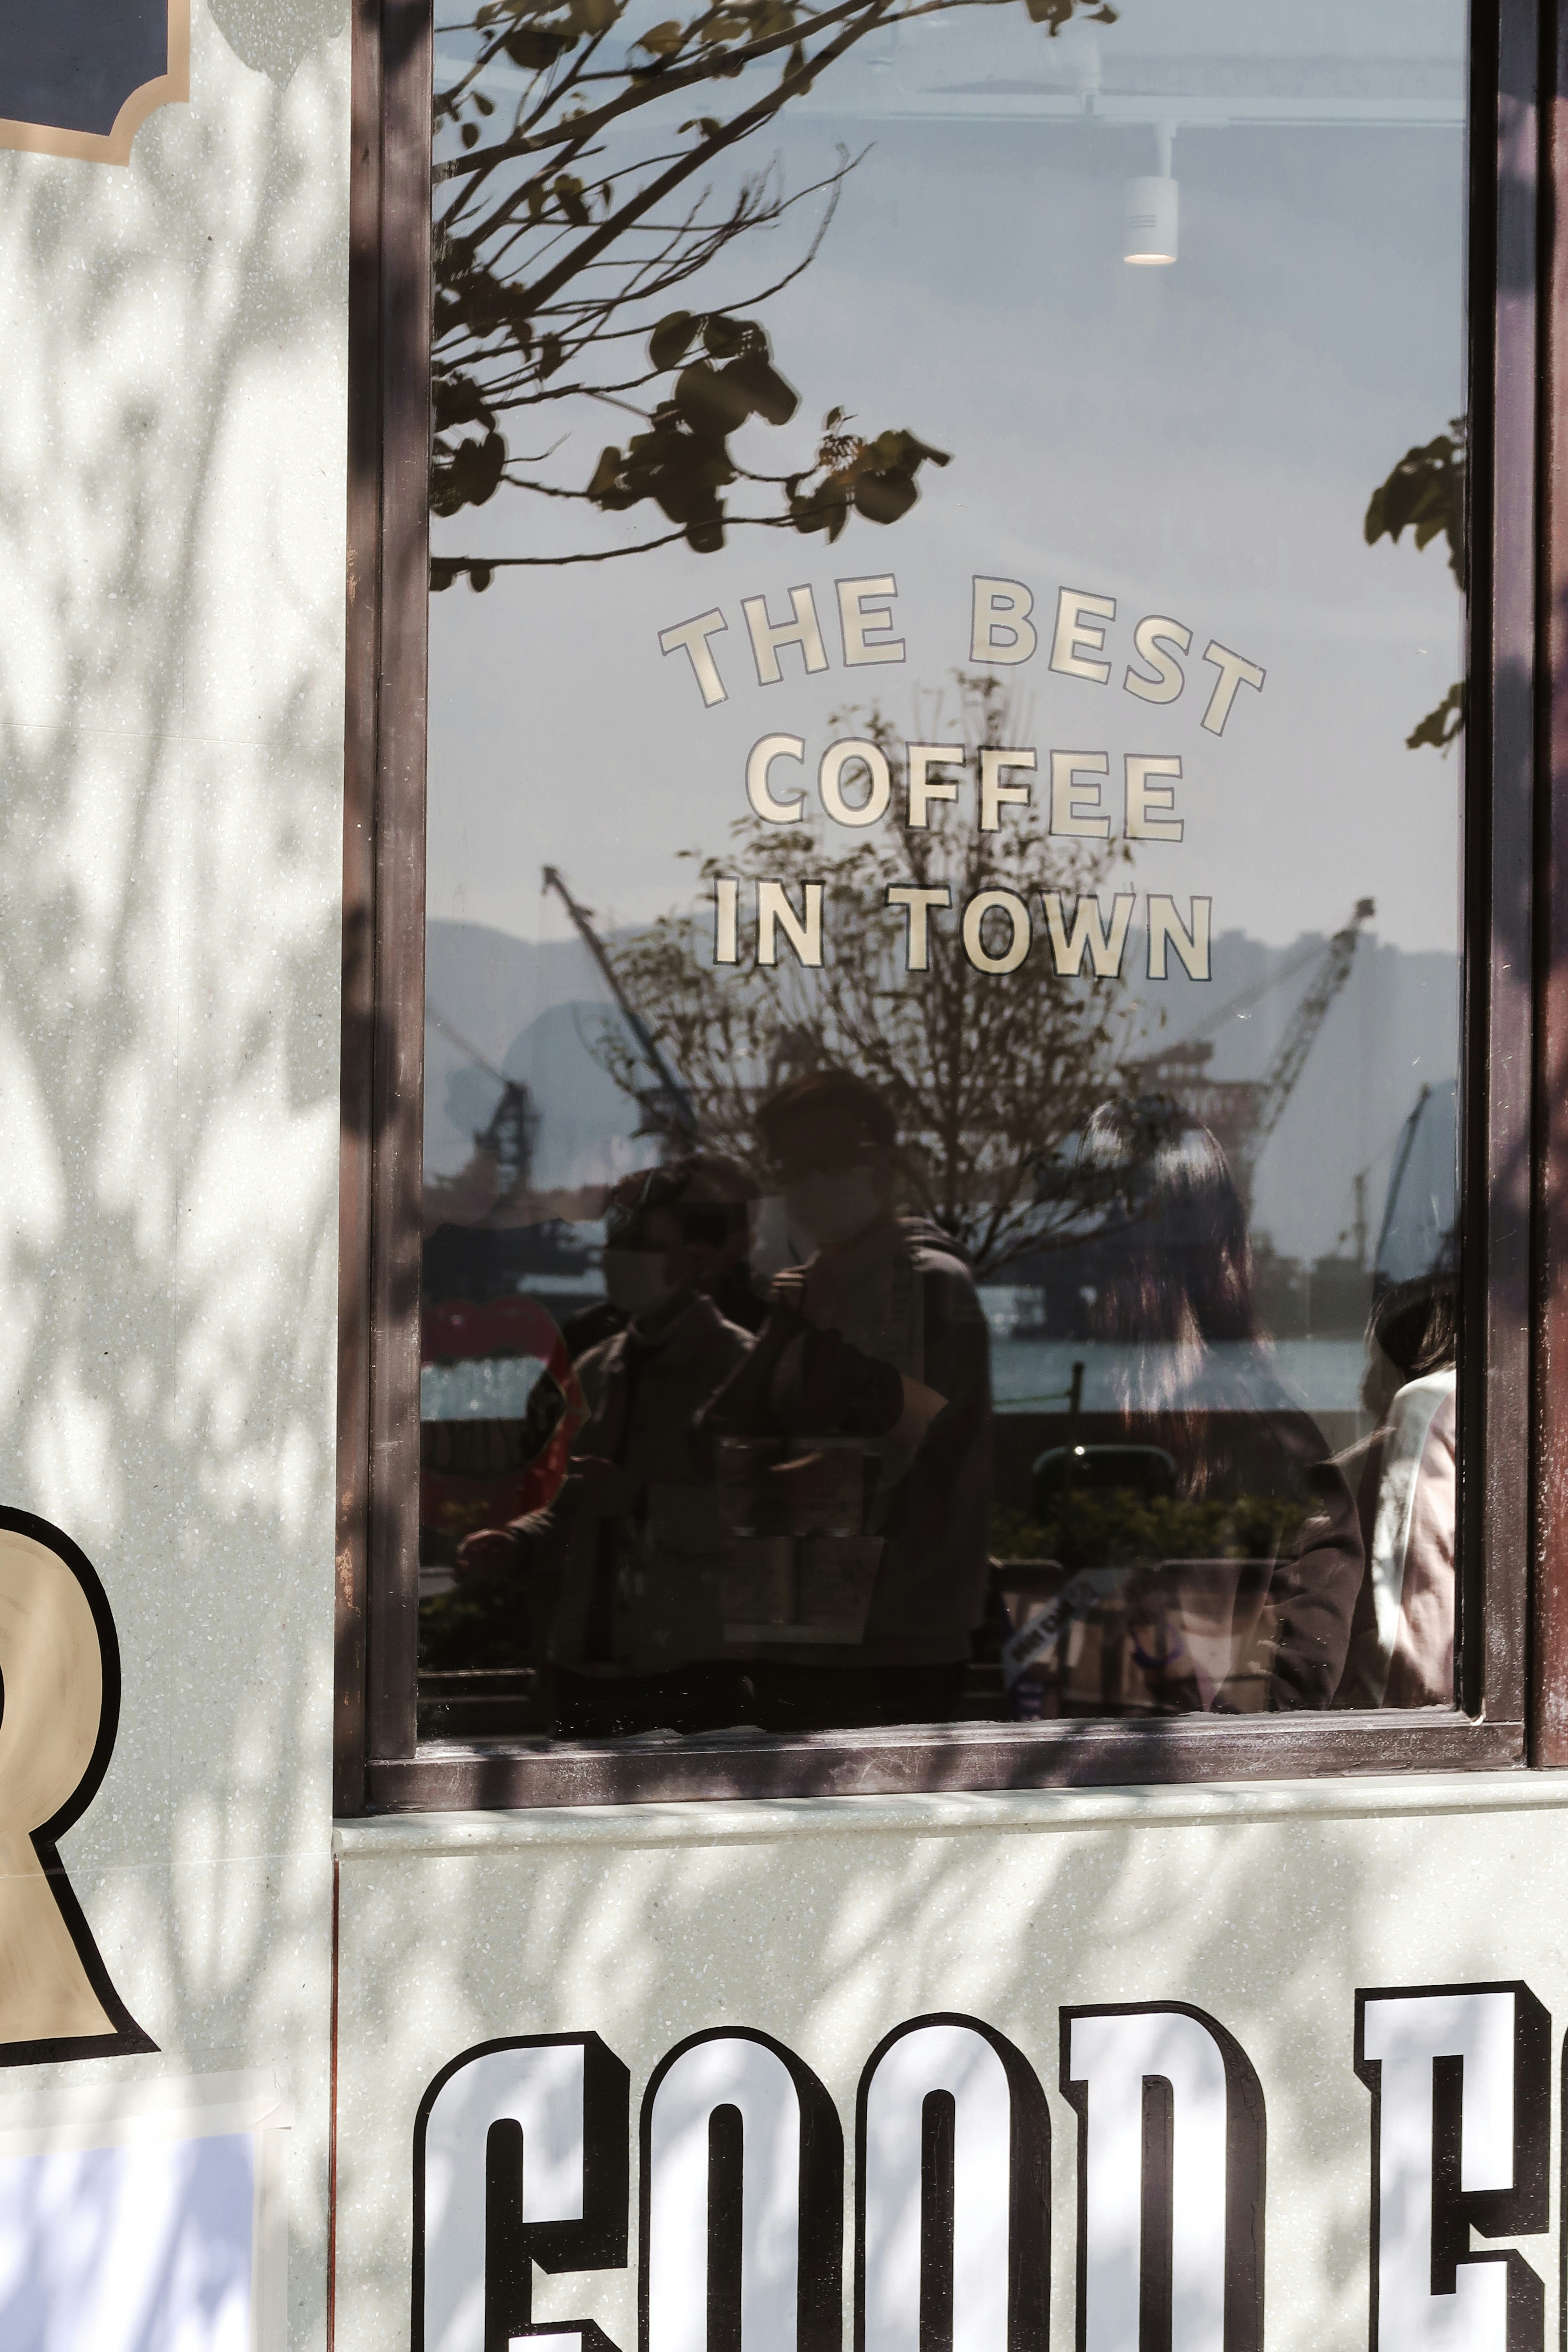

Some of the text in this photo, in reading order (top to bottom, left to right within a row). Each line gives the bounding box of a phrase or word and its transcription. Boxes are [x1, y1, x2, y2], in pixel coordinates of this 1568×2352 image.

[657, 573, 1266, 737] THE BEST
[745, 732, 1185, 842] COFFEE
[713, 875, 1212, 982] IN TOWN
